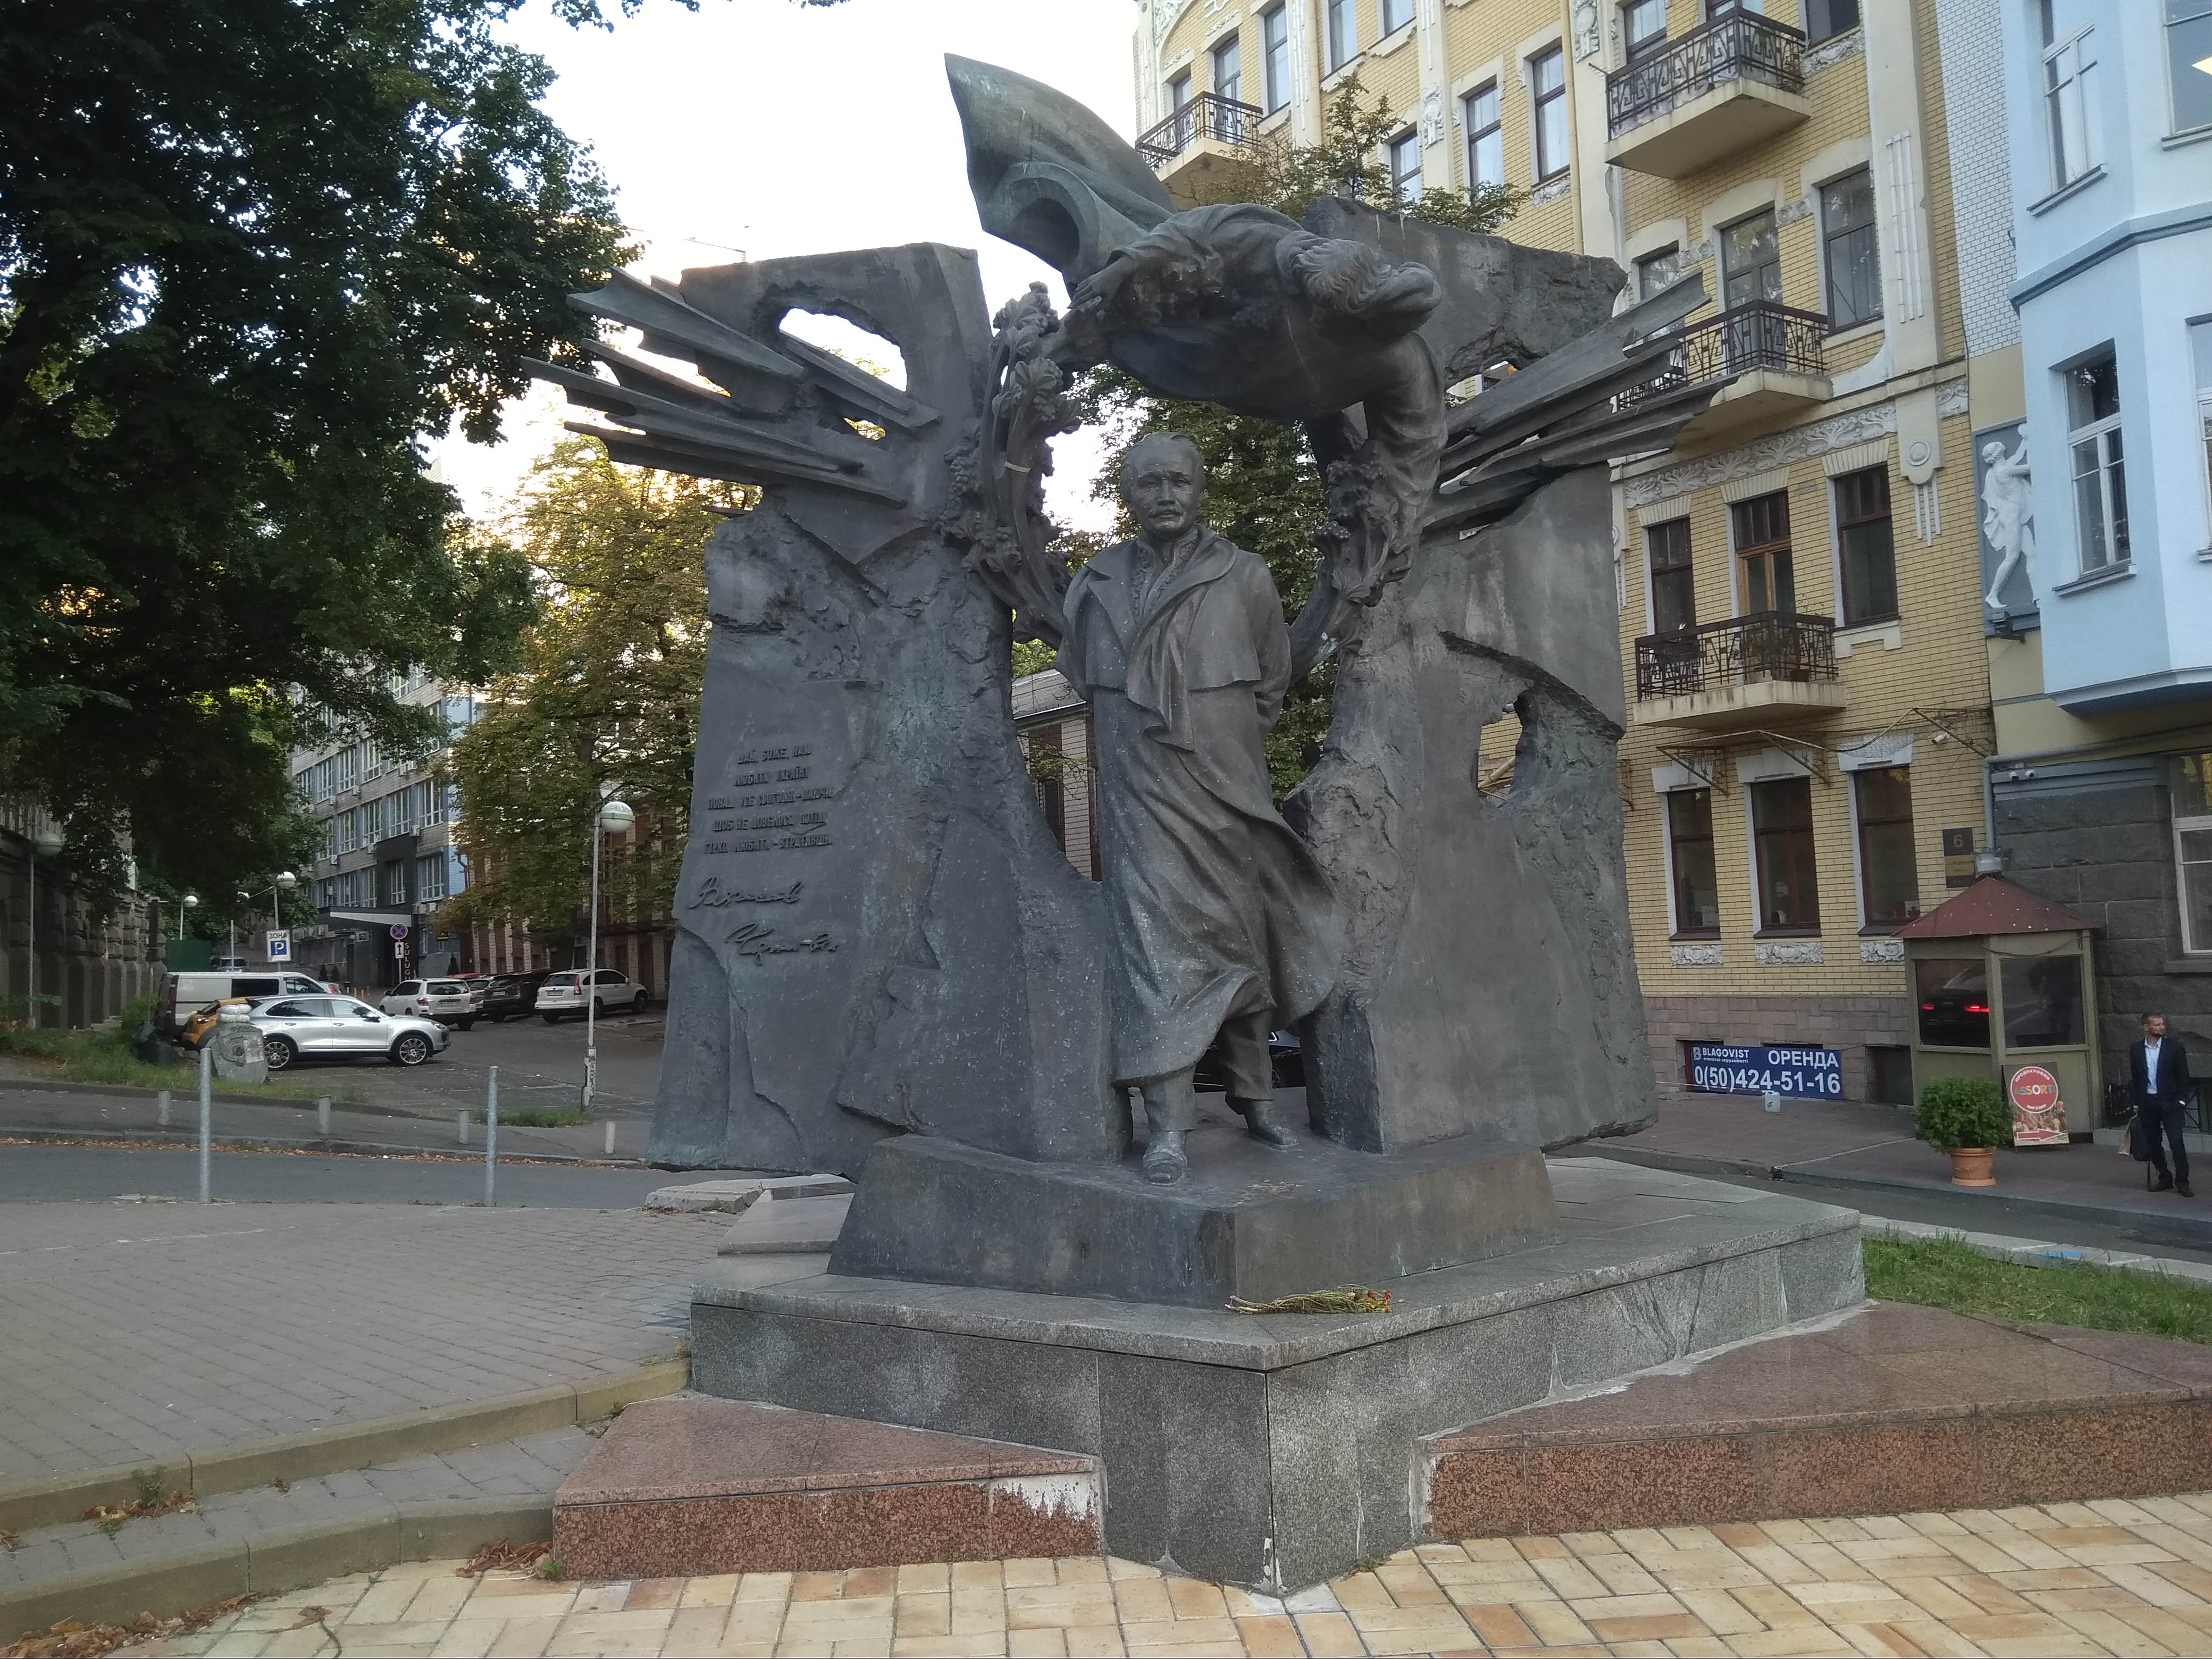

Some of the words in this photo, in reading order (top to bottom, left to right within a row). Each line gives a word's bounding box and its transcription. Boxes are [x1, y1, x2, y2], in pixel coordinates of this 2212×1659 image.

[736, 818, 748, 831] НЕ
[1954, 834, 1963, 848] 6
[274, 942, 284, 954] P
[1703, 1047, 1749, 1058] BLAGOVIST
[1768, 1050, 1839, 1070] ОРЕНДА
[1694, 1066, 1840, 1093] 0(50)424-51-16
